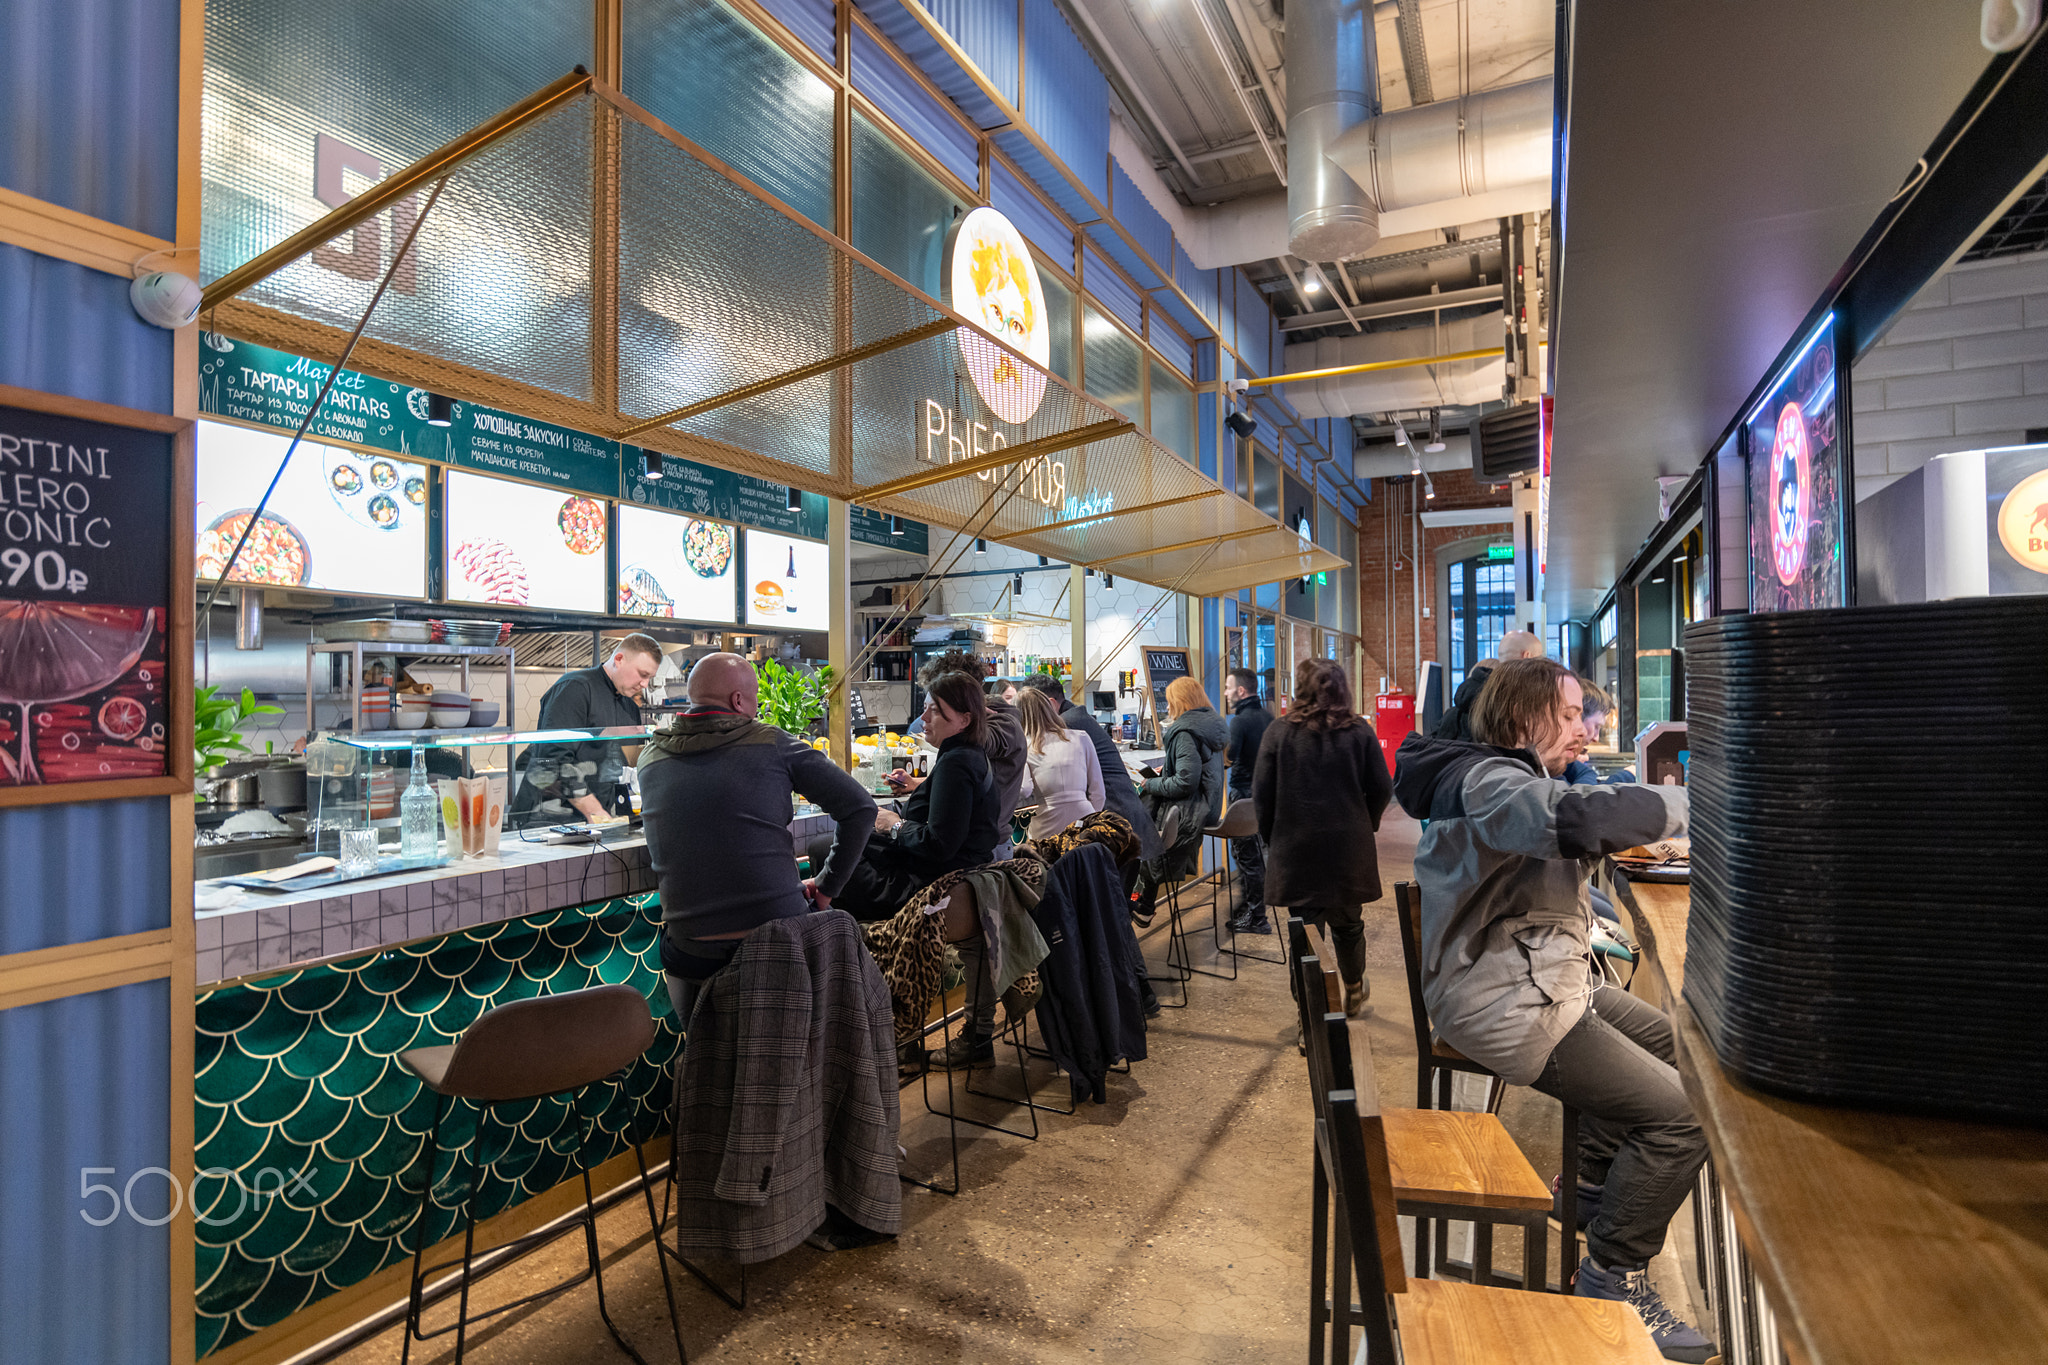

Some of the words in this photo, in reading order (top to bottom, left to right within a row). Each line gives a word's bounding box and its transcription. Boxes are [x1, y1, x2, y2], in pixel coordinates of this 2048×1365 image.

[226, 387, 264, 405] ТАРТАР
[268, 396, 282, 408] ИЗ
[323, 410, 331, 421] С
[332, 411, 367, 429] АВОКАДО
[240, 366, 309, 400] ТАРТАРЫ
[320, 386, 391, 419] TARTARS
[227, 403, 264, 421] ТАРТАР
[268, 412, 282, 425] ИЗ
[283, 414, 315, 433] ТУНА
[316, 423, 324, 435] С
[325, 424, 364, 443] АВОКАДО
[473, 413, 522, 439] ХОЛОДНЫЕ
[523, 424, 564, 449] ЗАКУСКИ
[471, 436, 501, 451] СЕВИЧЕ
[503, 443, 514, 454] ИЗ
[515, 445, 544, 460] ФОРЕЛИ
[572, 437, 592, 448] COLD
[573, 445, 607, 459] STARTERS
[471, 450, 518, 470] МАГАДАНСКИЕ
[519, 460, 551, 477] КРЕВЕТКИ
[0, 547, 89, 594] 90₽
[1151, 654, 1182, 669] WINE
